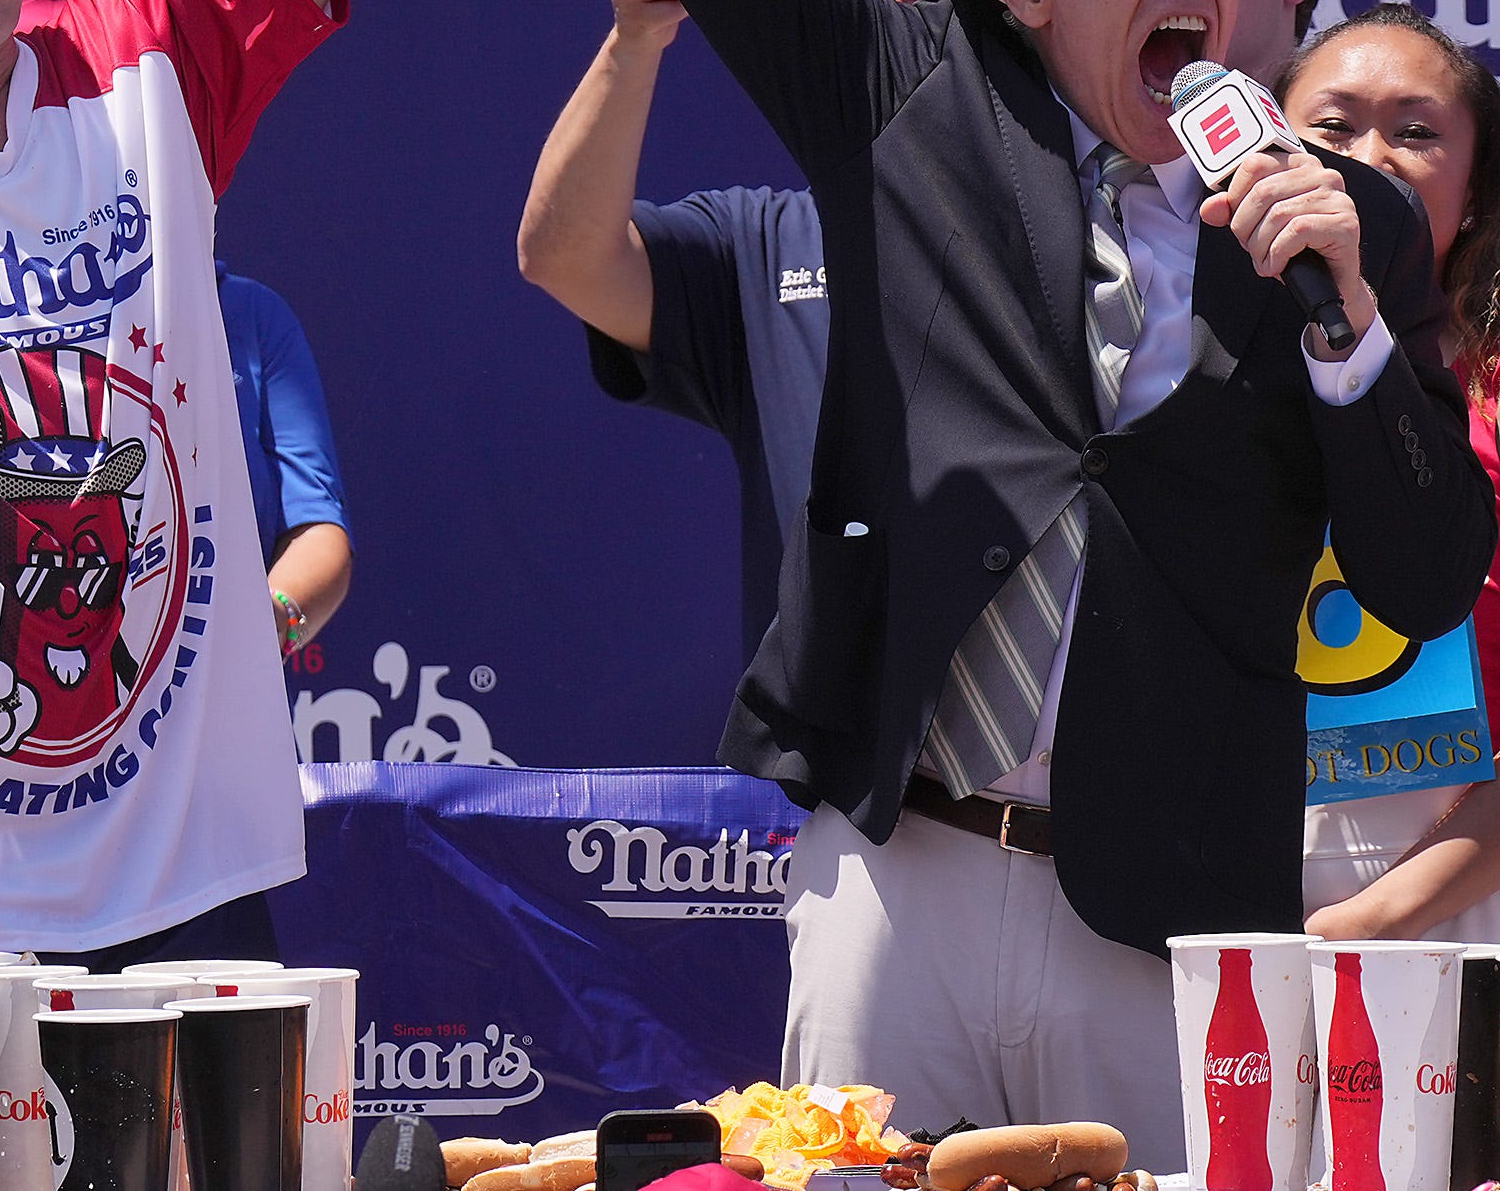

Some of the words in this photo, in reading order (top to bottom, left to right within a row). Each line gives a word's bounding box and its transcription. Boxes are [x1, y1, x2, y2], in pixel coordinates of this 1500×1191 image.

[42, 220, 88, 245] Since
[89, 204, 115, 228] 1916
[1361, 730, 1482, 778] DOGS
[685, 906, 784, 917] FAMOU
[393, 1024, 433, 1037] Since
[436, 1024, 467, 1037] 1916
[1205, 1051, 1270, 1086] Coca-Cola
